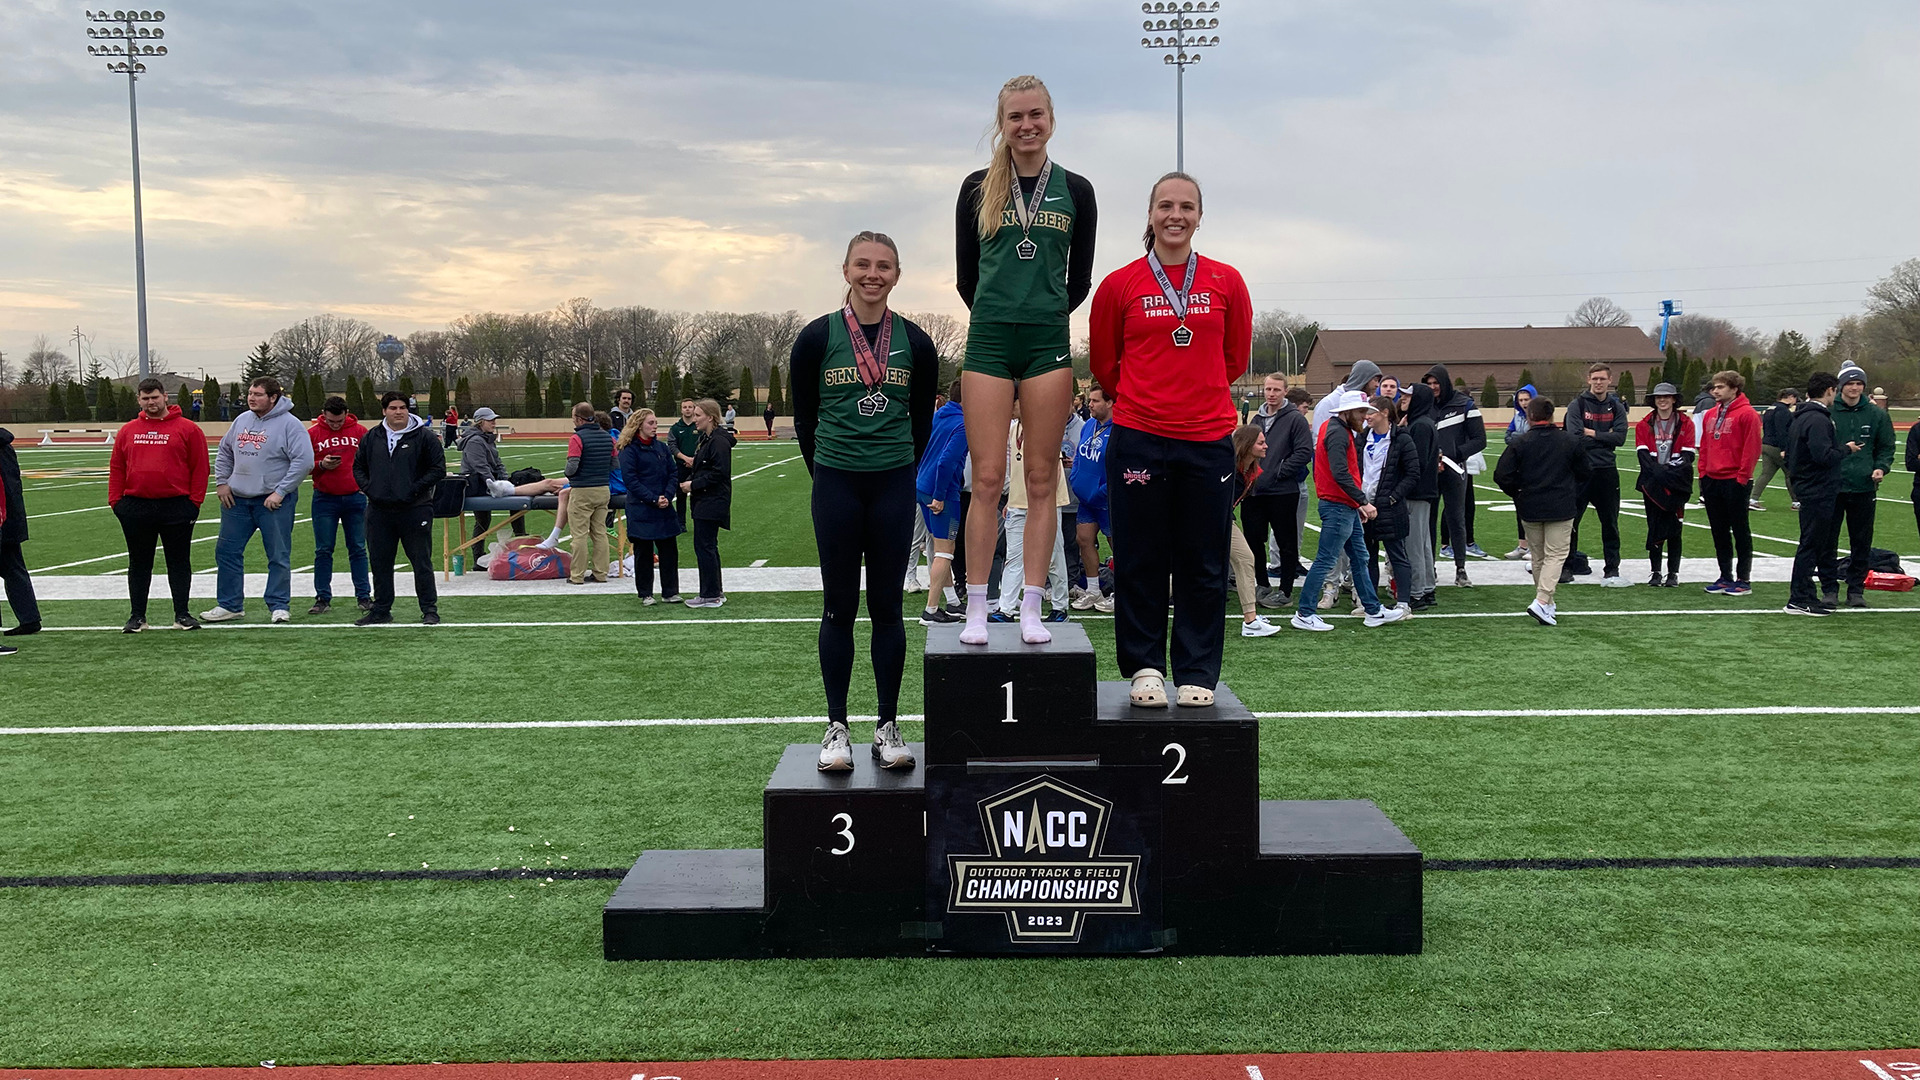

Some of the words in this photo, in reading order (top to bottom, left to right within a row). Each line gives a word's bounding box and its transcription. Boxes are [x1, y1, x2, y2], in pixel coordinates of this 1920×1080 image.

[1001, 210, 1071, 232] NBERT
[1145, 308, 1175, 318] TRACK
[317, 436, 359, 452] MSOE
[1079, 444, 1101, 463] CUW
[1001, 681, 1018, 723] 1
[1161, 743, 1189, 784] 2
[830, 812, 855, 856] 3
[1003, 798, 1087, 854] NACC
[969, 868, 1026, 878] OUTDOOR
[1030, 868, 1070, 878] TRACK
[1074, 868, 1082, 878] &
[1086, 868, 1121, 878] FIELD
[966, 879, 1119, 900] CHAMPIONSHIPS
[1028, 916, 1062, 926] 2023
